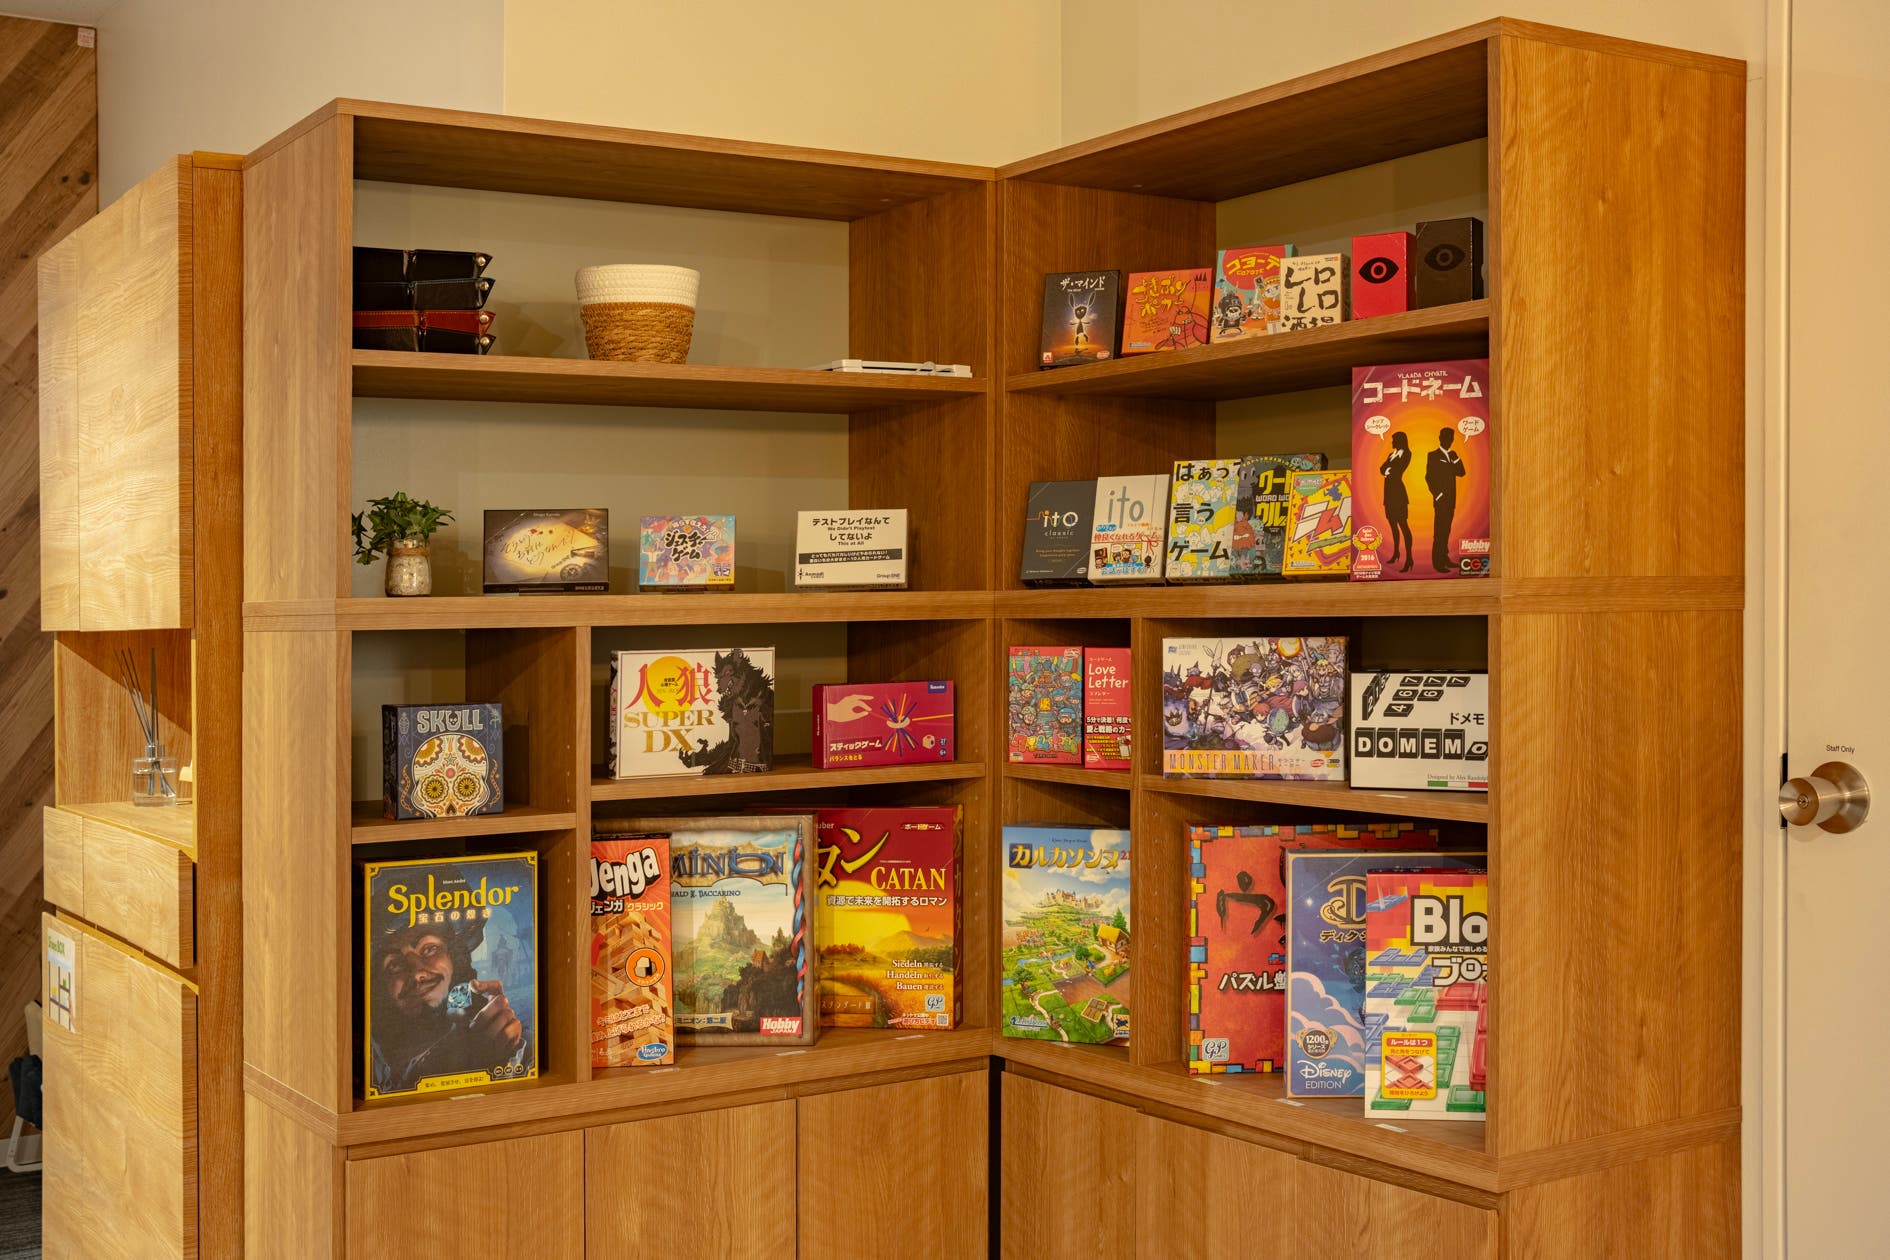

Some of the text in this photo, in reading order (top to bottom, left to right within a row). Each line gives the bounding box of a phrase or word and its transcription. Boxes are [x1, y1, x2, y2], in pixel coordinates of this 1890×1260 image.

[1226, 255, 1281, 275] コヨーテ
[1236, 268, 1264, 276] COYOTE
[1060, 276, 1105, 290] ザ・マインド
[1363, 375, 1483, 404] コードネーム
[1255, 494, 1278, 502] WORD
[1107, 486, 1144, 529] ito
[1173, 502, 1215, 524] 言う
[812, 517, 890, 526] テストプレイなんて
[1043, 510, 1079, 528] ito
[829, 533, 873, 541] してないよ
[1169, 541, 1230, 562] ゲーム
[1461, 540, 1490, 552] Hobby
[671, 546, 701, 562] ゲーム
[1088, 663, 1117, 675] Love
[624, 662, 715, 711] 人狼
[1088, 675, 1129, 689] Letter
[416, 709, 484, 734] SKULL
[623, 709, 715, 729] SUPER
[1450, 712, 1485, 725] ドメモ
[642, 728, 696, 754] DX
[829, 739, 882, 752] スティックゲーム
[1358, 736, 1487, 754] DOMEMO
[1840, 746, 1855, 754] Only
[1169, 754, 1275, 770] MONSTER MAKER
[904, 823, 942, 831] ボードゲーム
[1011, 844, 1120, 870] カルカソンヌ
[870, 866, 947, 891] CATAN
[387, 874, 520, 928] Splendor
[627, 901, 663, 912] クラシック
[827, 895, 947, 906] 資源で未来を開拓するロマン
[1413, 898, 1487, 943] Blo
[892, 959, 923, 968] Siedeln
[886, 970, 923, 979] Handeln
[1432, 956, 1487, 987] ブロ
[896, 981, 923, 990] Bauen
[762, 1018, 801, 1033] Hobby
[641, 1045, 666, 1054] Hasbro
[1305, 1081, 1342, 1089] EDITION
